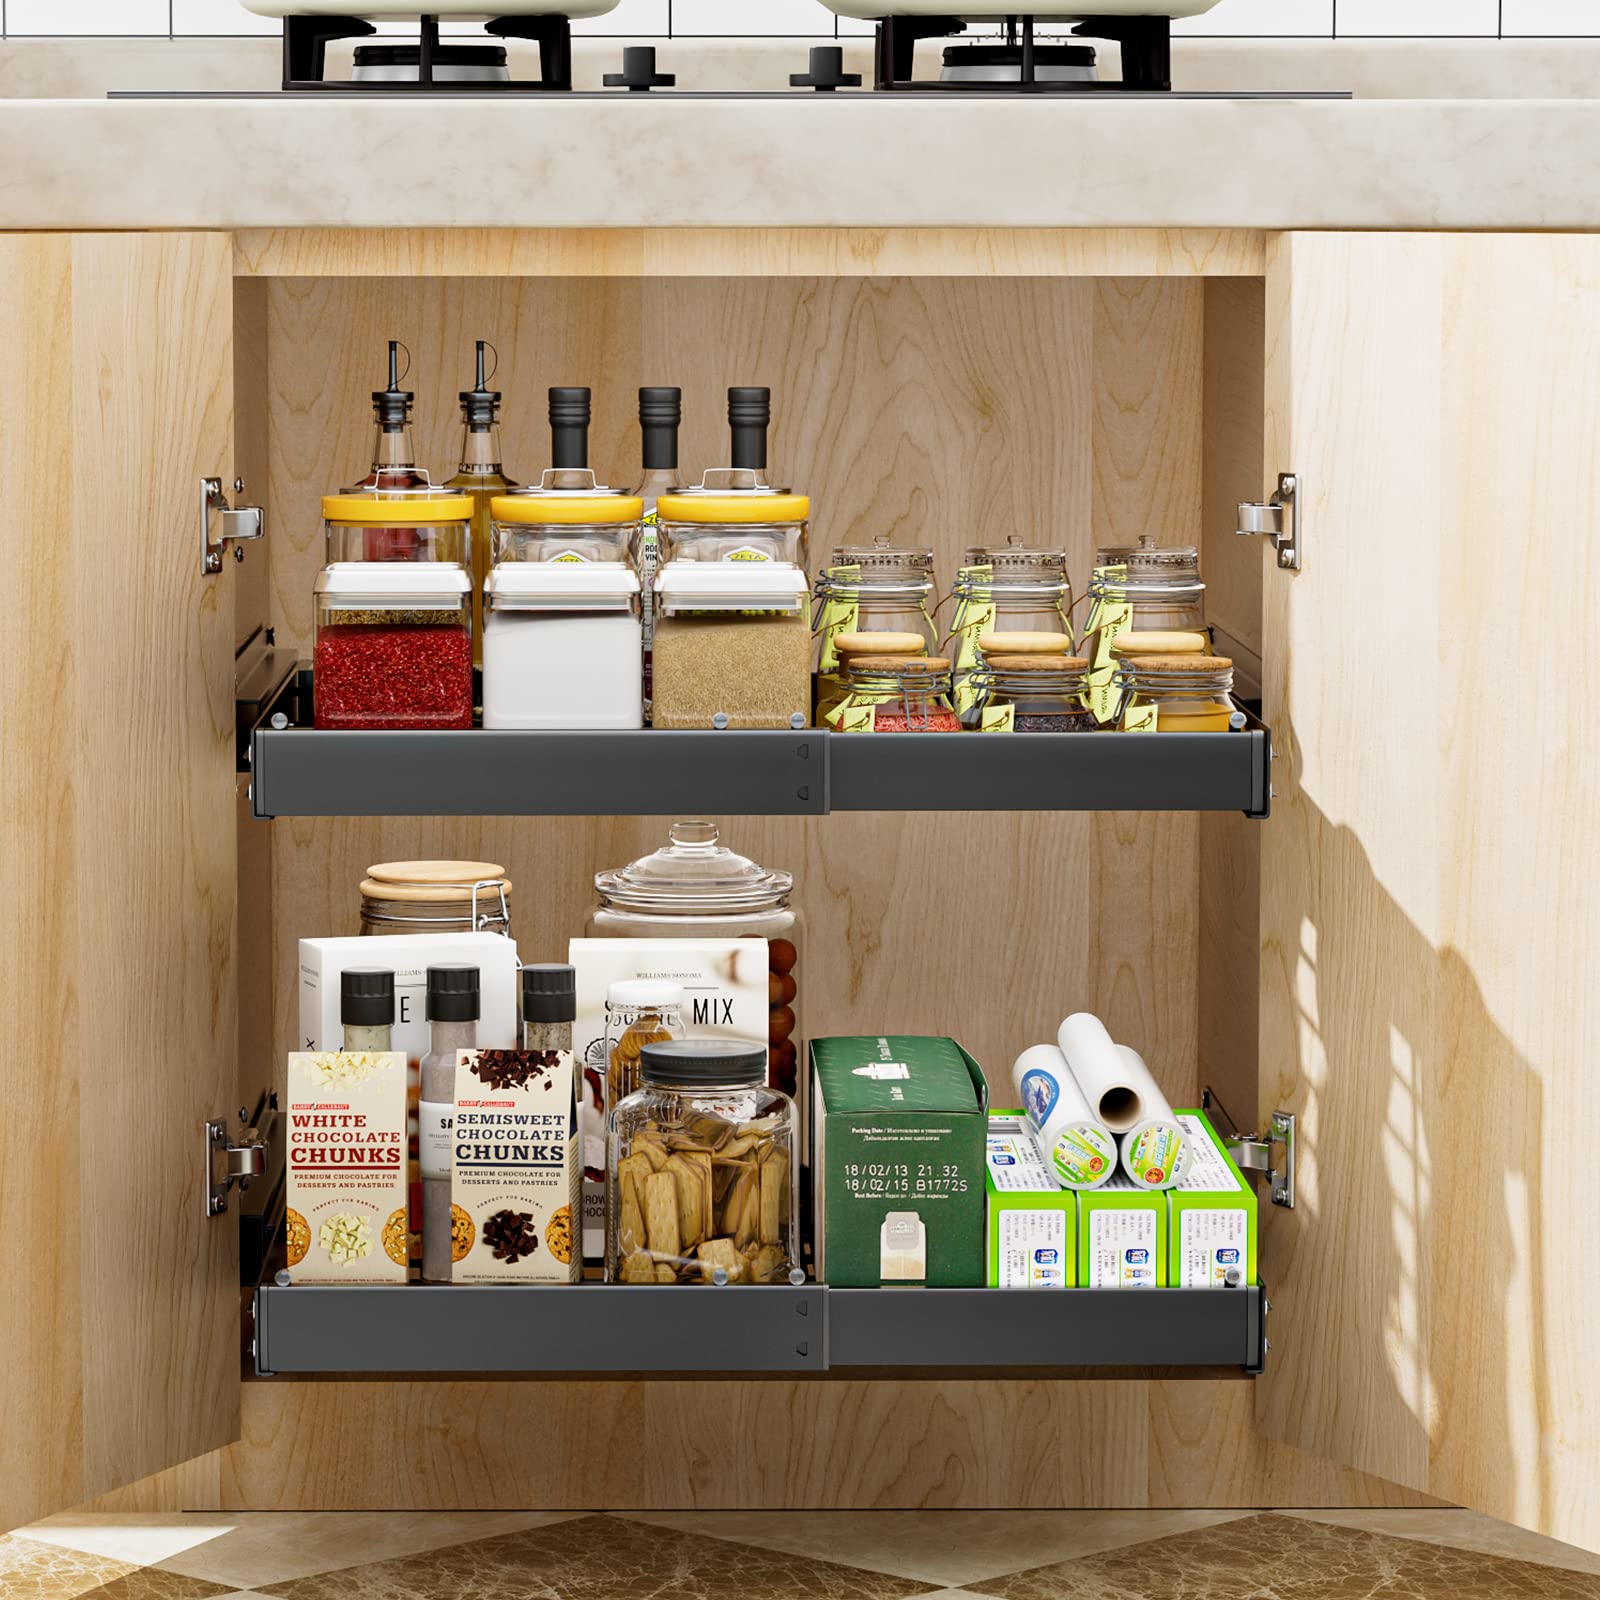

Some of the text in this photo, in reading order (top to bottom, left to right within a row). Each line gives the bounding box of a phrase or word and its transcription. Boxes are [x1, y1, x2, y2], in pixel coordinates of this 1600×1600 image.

[400, 996, 411, 1023] E
[693, 998, 734, 1025] MIX
[291, 1115, 367, 1128] WHITE
[440, 1118, 453, 1129] SA
[457, 1114, 565, 1125] SEMISWEET
[291, 1132, 400, 1143] CHOCOLATE
[456, 1129, 564, 1141] CHOCOLATE
[291, 1147, 401, 1163] CHUNKS
[455, 1144, 564, 1161] CHUNKS
[585, 1194, 606, 1205] ROW
